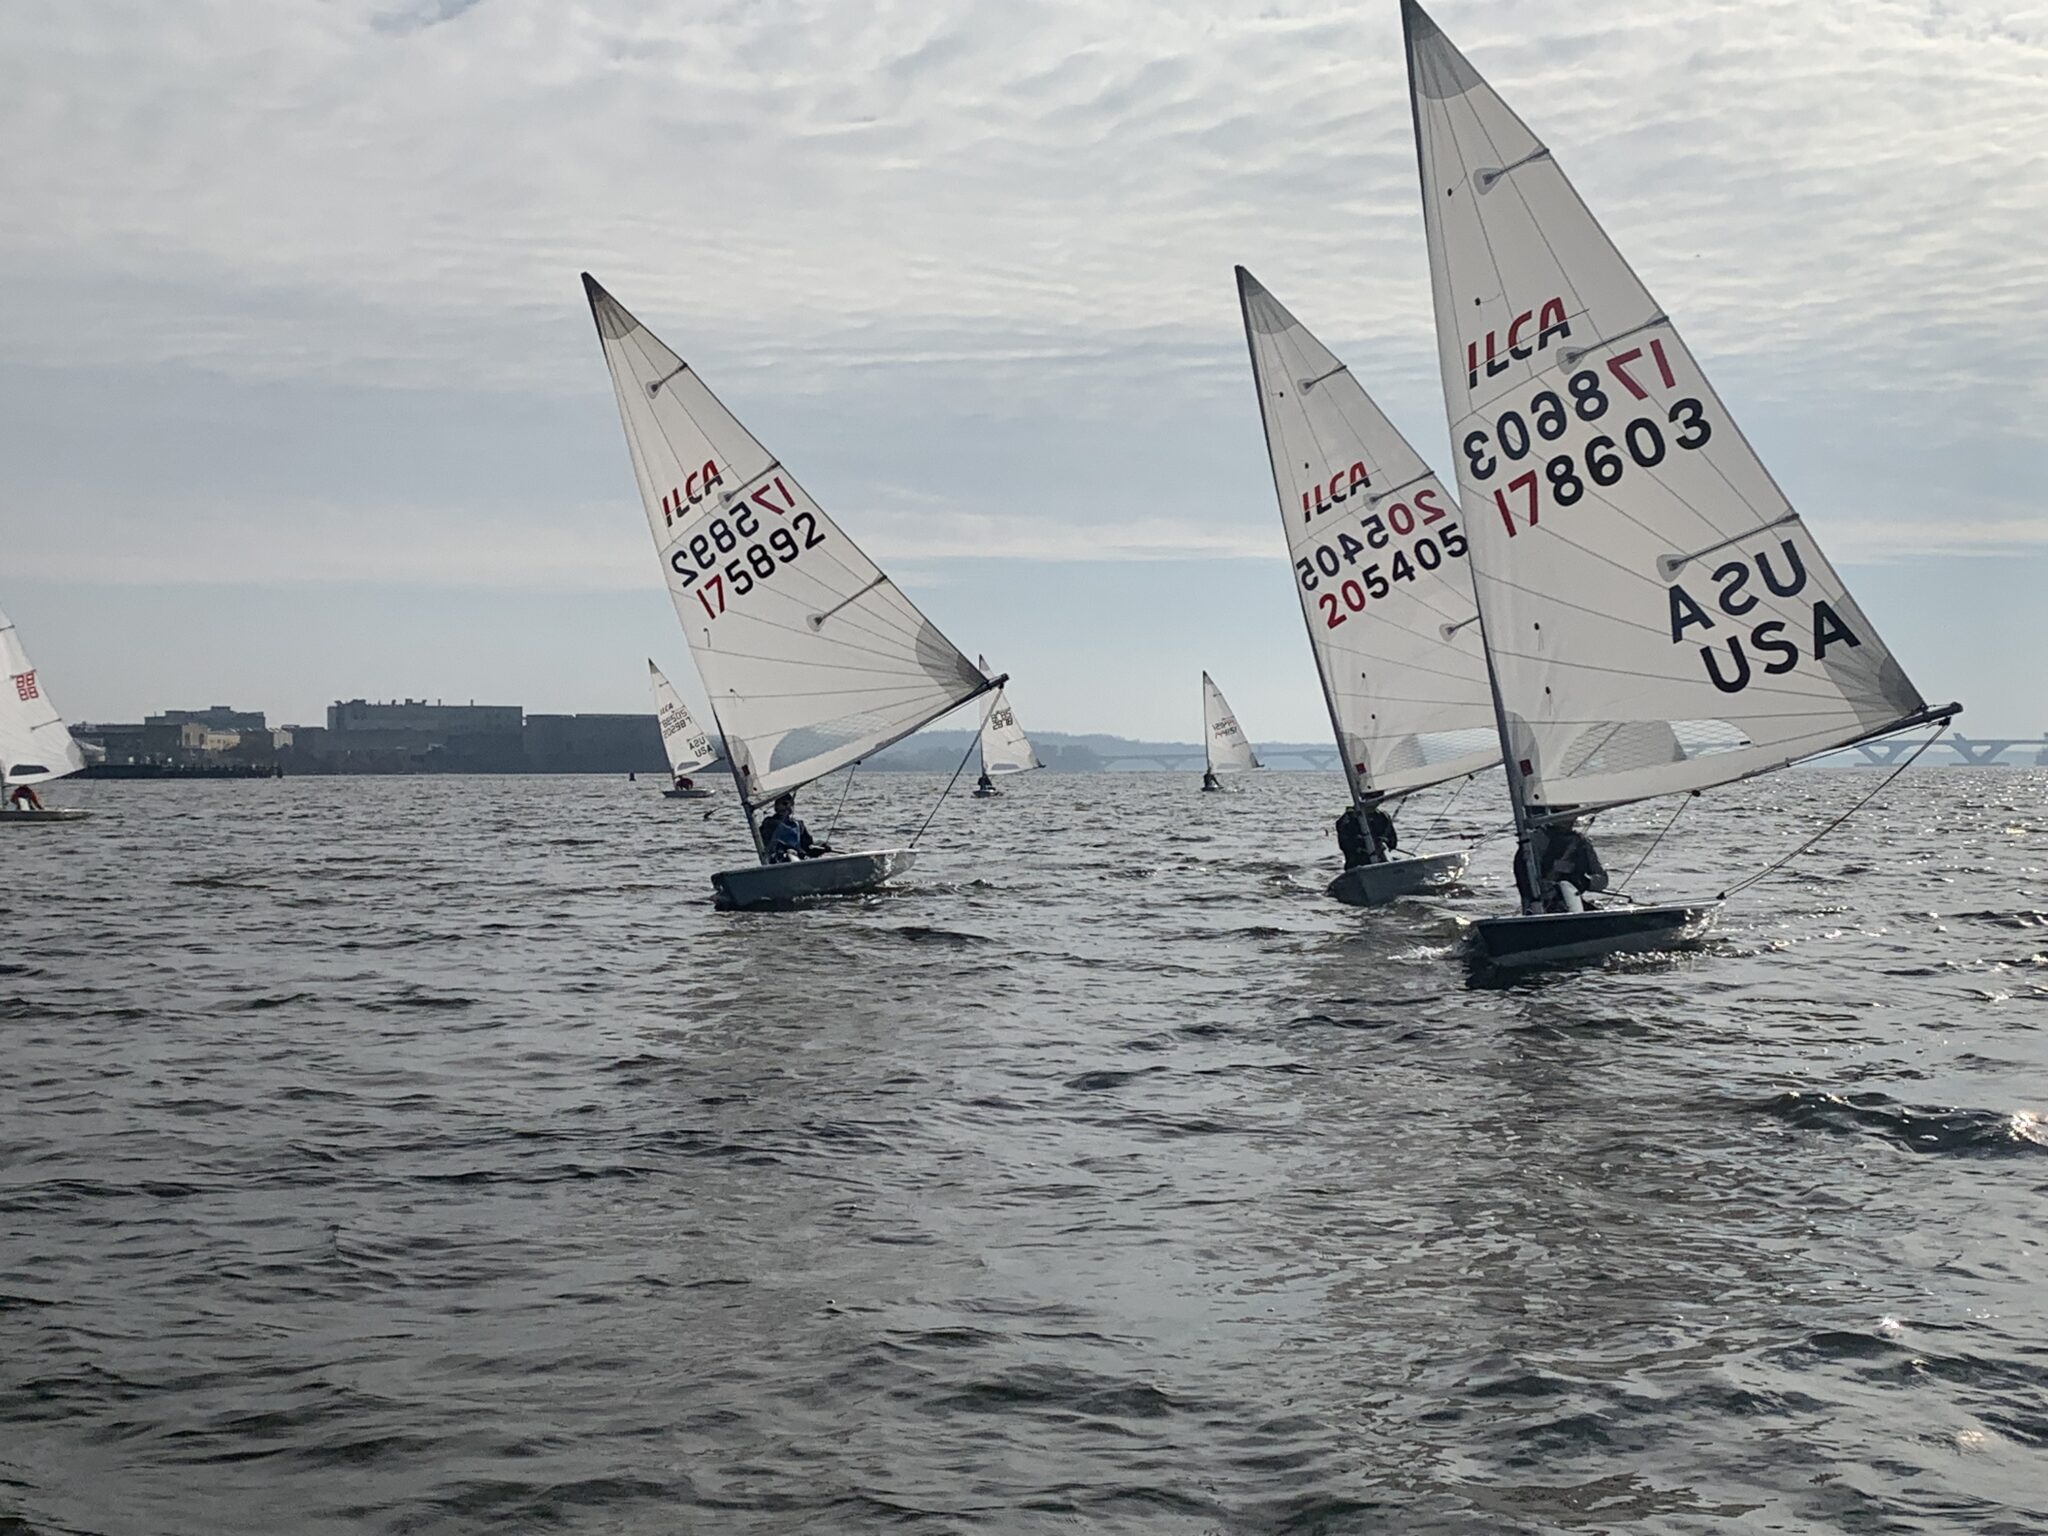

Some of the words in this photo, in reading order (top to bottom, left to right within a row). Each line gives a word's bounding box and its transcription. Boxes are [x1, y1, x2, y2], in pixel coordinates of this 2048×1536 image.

[1468, 297, 1571, 390] ILCA
[662, 459, 724, 528] ILCA
[1302, 461, 1371, 523] ILCA
[1494, 398, 1712, 538] 178603
[696, 512, 826, 620] 175892
[1318, 522, 1469, 630] 205405
[1700, 600, 1862, 693] USA
[694, 745, 713, 758] USA
